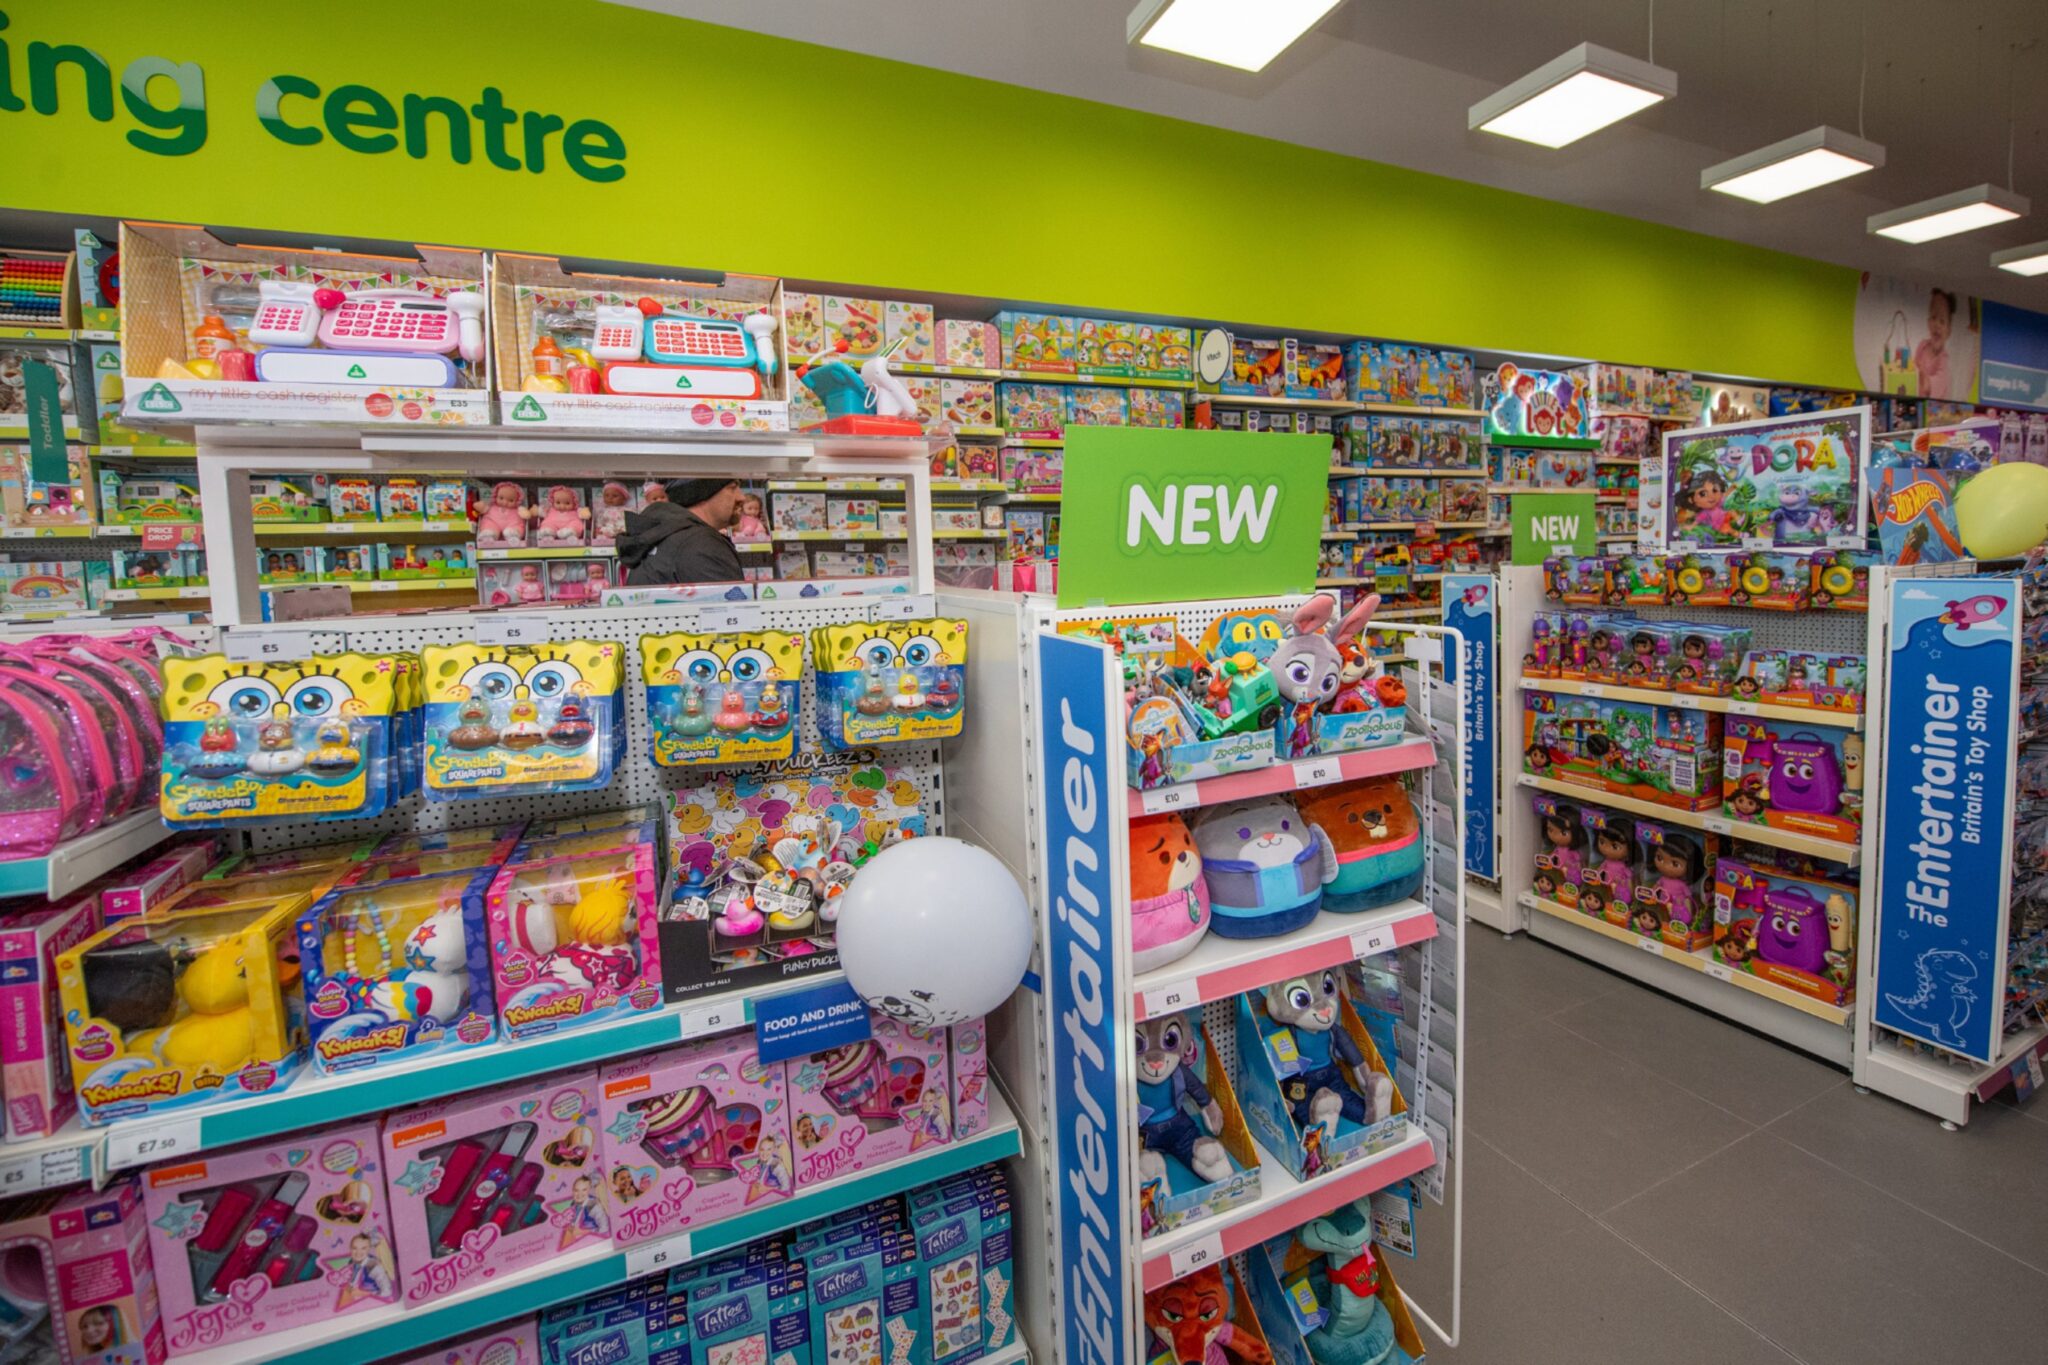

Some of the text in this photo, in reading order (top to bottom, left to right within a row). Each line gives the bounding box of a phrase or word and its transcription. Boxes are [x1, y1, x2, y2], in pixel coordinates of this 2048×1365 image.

[256, 75, 626, 183] centre
[188, 387, 217, 400] my
[220, 386, 251, 400] little
[255, 388, 295, 401] cash
[299, 390, 359, 406] register
[450, 400, 469, 408] £35
[552, 398, 687, 416] my little cash register
[39, 396, 53, 450] Toddler
[1752, 437, 1838, 476] DORA
[1891, 488, 1914, 522] HOT
[1127, 484, 1278, 548] NEW
[1531, 515, 1579, 543] NEW
[148, 534, 173, 542] DROP
[726, 617, 738, 626] £5
[507, 629, 521, 637] £5
[262, 644, 279, 653] £5
[1474, 640, 1486, 742] Britain's Toy Shop
[1727, 719, 1766, 740] DORA
[775, 751, 858, 773] DUCKEEZ
[1961, 685, 1993, 844] Britain's Toy Shop
[447, 767, 503, 781] SQUAREPANTS
[1313, 769, 1326, 778] £10
[1165, 793, 1179, 803] £10
[1905, 673, 1960, 927] The Entertainer
[187, 798, 251, 812] SQUAREPANTS
[113, 899, 129, 908] 5+
[4, 941, 23, 952] 5+
[675, 983, 703, 993] COLLECT
[717, 978, 731, 986] ALL!
[1166, 993, 1181, 1005] £13
[468, 1012, 477, 1021] 3
[708, 1015, 721, 1025] £3
[764, 1000, 862, 1032] FOOD AND DRINK
[1057, 697, 1113, 1365] Entertainer
[5, 1170, 24, 1184] £5
[982, 1207, 994, 1217] 5+
[58, 1219, 77, 1231] 5+
[861, 1219, 875, 1229] 5+
[882, 1237, 896, 1246] 5+
[654, 1252, 667, 1263] £5
[884, 1254, 898, 1263] 5+
[1191, 1250, 1207, 1264] £20
[769, 1268, 784, 1277] 5+
[818, 1270, 862, 1298] Tattoo
[629, 1288, 644, 1298] 5+
[770, 1286, 785, 1296] 5+
[649, 1301, 664, 1310] 5+
[649, 1318, 665, 1330] 5+
[698, 1302, 745, 1333] Tattoo
[571, 1336, 622, 1365] Tattoo
